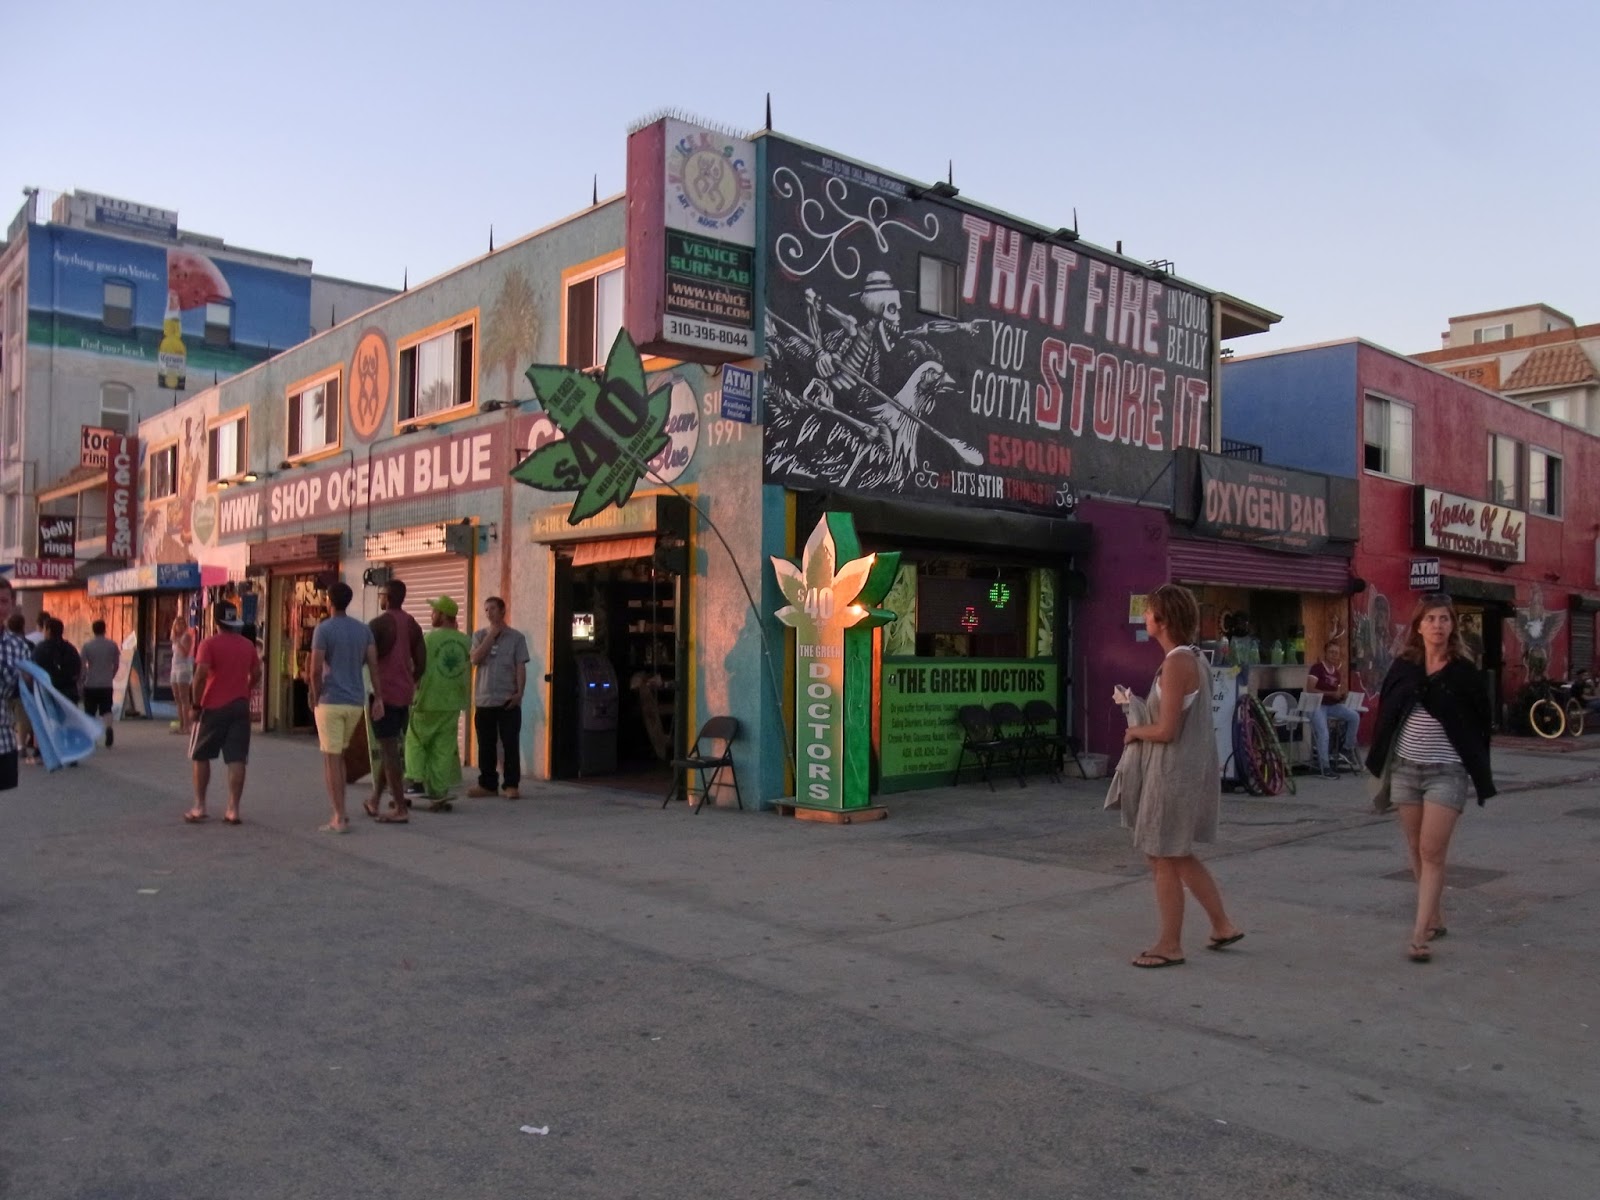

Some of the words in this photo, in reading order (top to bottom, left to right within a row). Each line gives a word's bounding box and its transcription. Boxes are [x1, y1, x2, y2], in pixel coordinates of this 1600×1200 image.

[53, 249, 94, 271] Anything
[96, 261, 116, 272] goes
[119, 263, 128, 275] in
[683, 240, 739, 266] VENICE
[670, 256, 750, 285] SURF-LAB
[672, 282, 747, 307] WWW.VENICE
[962, 213, 1078, 331] THAT
[1084, 259, 1163, 357] FIRE
[668, 294, 750, 320] KIDSCLUB.COM
[1168, 289, 1178, 319] IN
[1178, 292, 1208, 333] YOUR
[670, 321, 748, 347] 310-396-8044
[990, 319, 1028, 372] YOU
[81, 338, 100, 349] Find
[122, 344, 145, 357] beach
[1166, 325, 1209, 371] BELLY
[725, 369, 751, 389] ATM
[970, 369, 1031, 425] GOTTA
[1035, 336, 1166, 451] STOKE
[727, 409, 746, 419] Inside
[707, 420, 742, 447] 1991
[82, 451, 107, 469] ring
[220, 493, 262, 533] WWW.
[271, 476, 322, 523] SHOP
[327, 454, 405, 511] OCEAN
[413, 433, 492, 493] BLUE
[596, 456, 627, 497] MEDICAL
[978, 476, 1004, 499] STIR
[1206, 479, 1285, 531] OXYGEN
[1291, 493, 1327, 536] BAR
[1430, 493, 1475, 535] House
[1480, 505, 1498, 539] Of
[40, 521, 73, 539] belly
[1437, 531, 1475, 553] TATTOOS
[44, 541, 73, 556] rings
[17, 562, 38, 576] toe
[41, 559, 74, 578] rings
[1411, 562, 1438, 575] ATM
[1411, 576, 1438, 586] INSIDE
[797, 587, 835, 621] $40
[799, 644, 815, 658] THE
[816, 645, 841, 658] GREEN
[897, 668, 926, 693] THE
[930, 668, 977, 693] GREEN
[981, 668, 1045, 693] DOCTORS
[807, 662, 832, 801] DOCTORS
